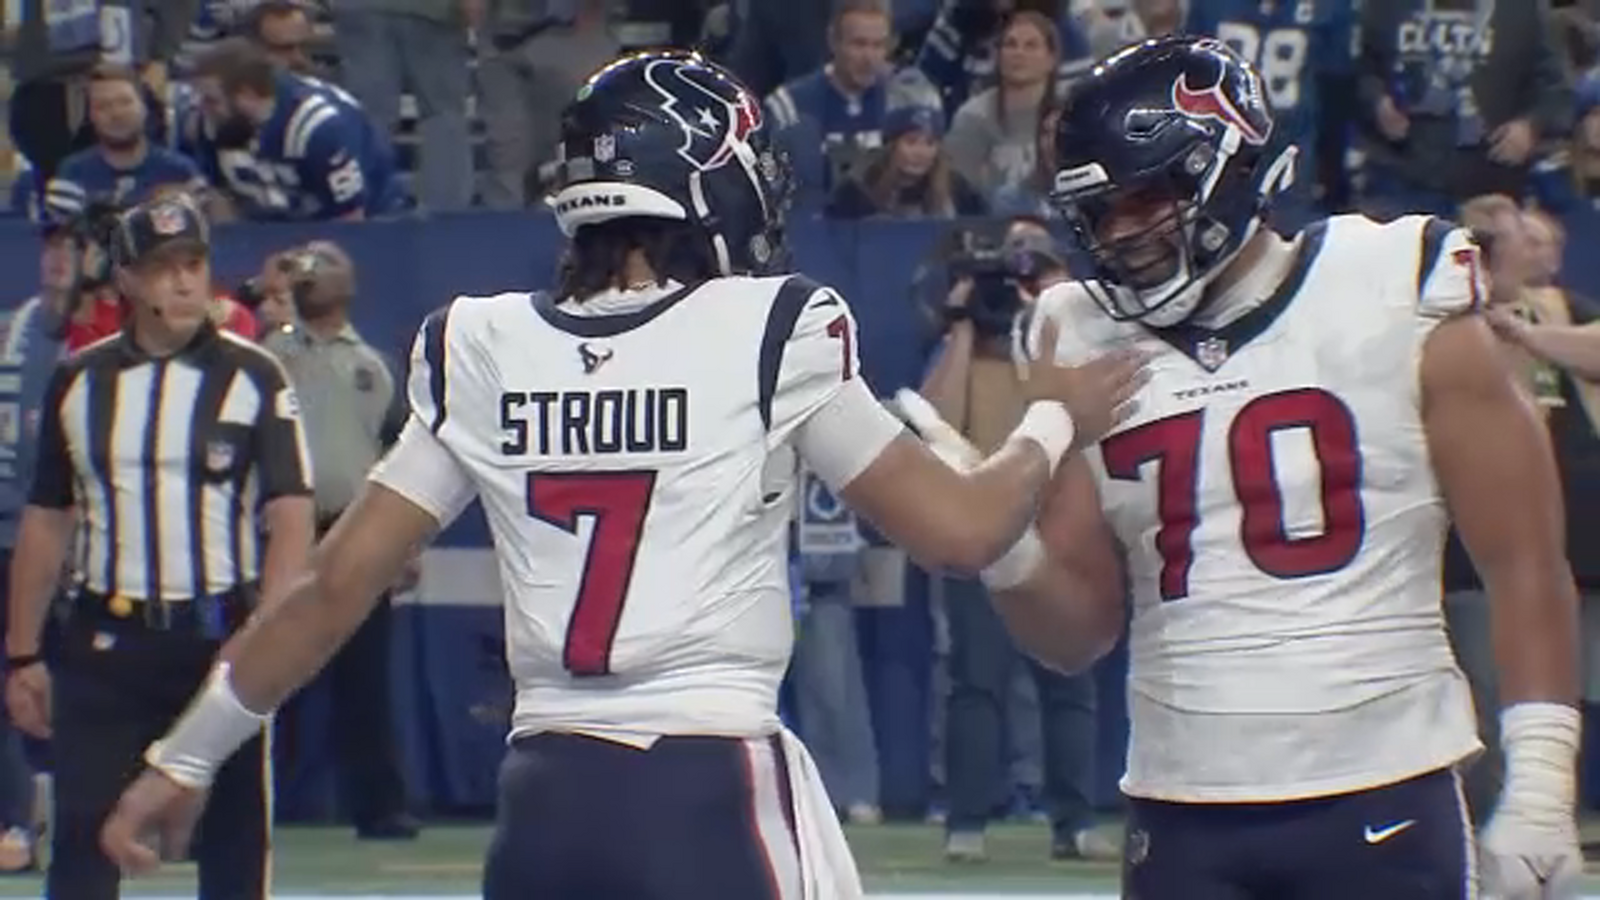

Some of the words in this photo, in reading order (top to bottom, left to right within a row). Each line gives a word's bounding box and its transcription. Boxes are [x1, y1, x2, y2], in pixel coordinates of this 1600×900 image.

[827, 313, 851, 382] 7
[501, 388, 688, 455] STROUD
[1172, 381, 1249, 400] TEXANS
[1100, 387, 1366, 602] 70
[526, 470, 658, 676] 7
